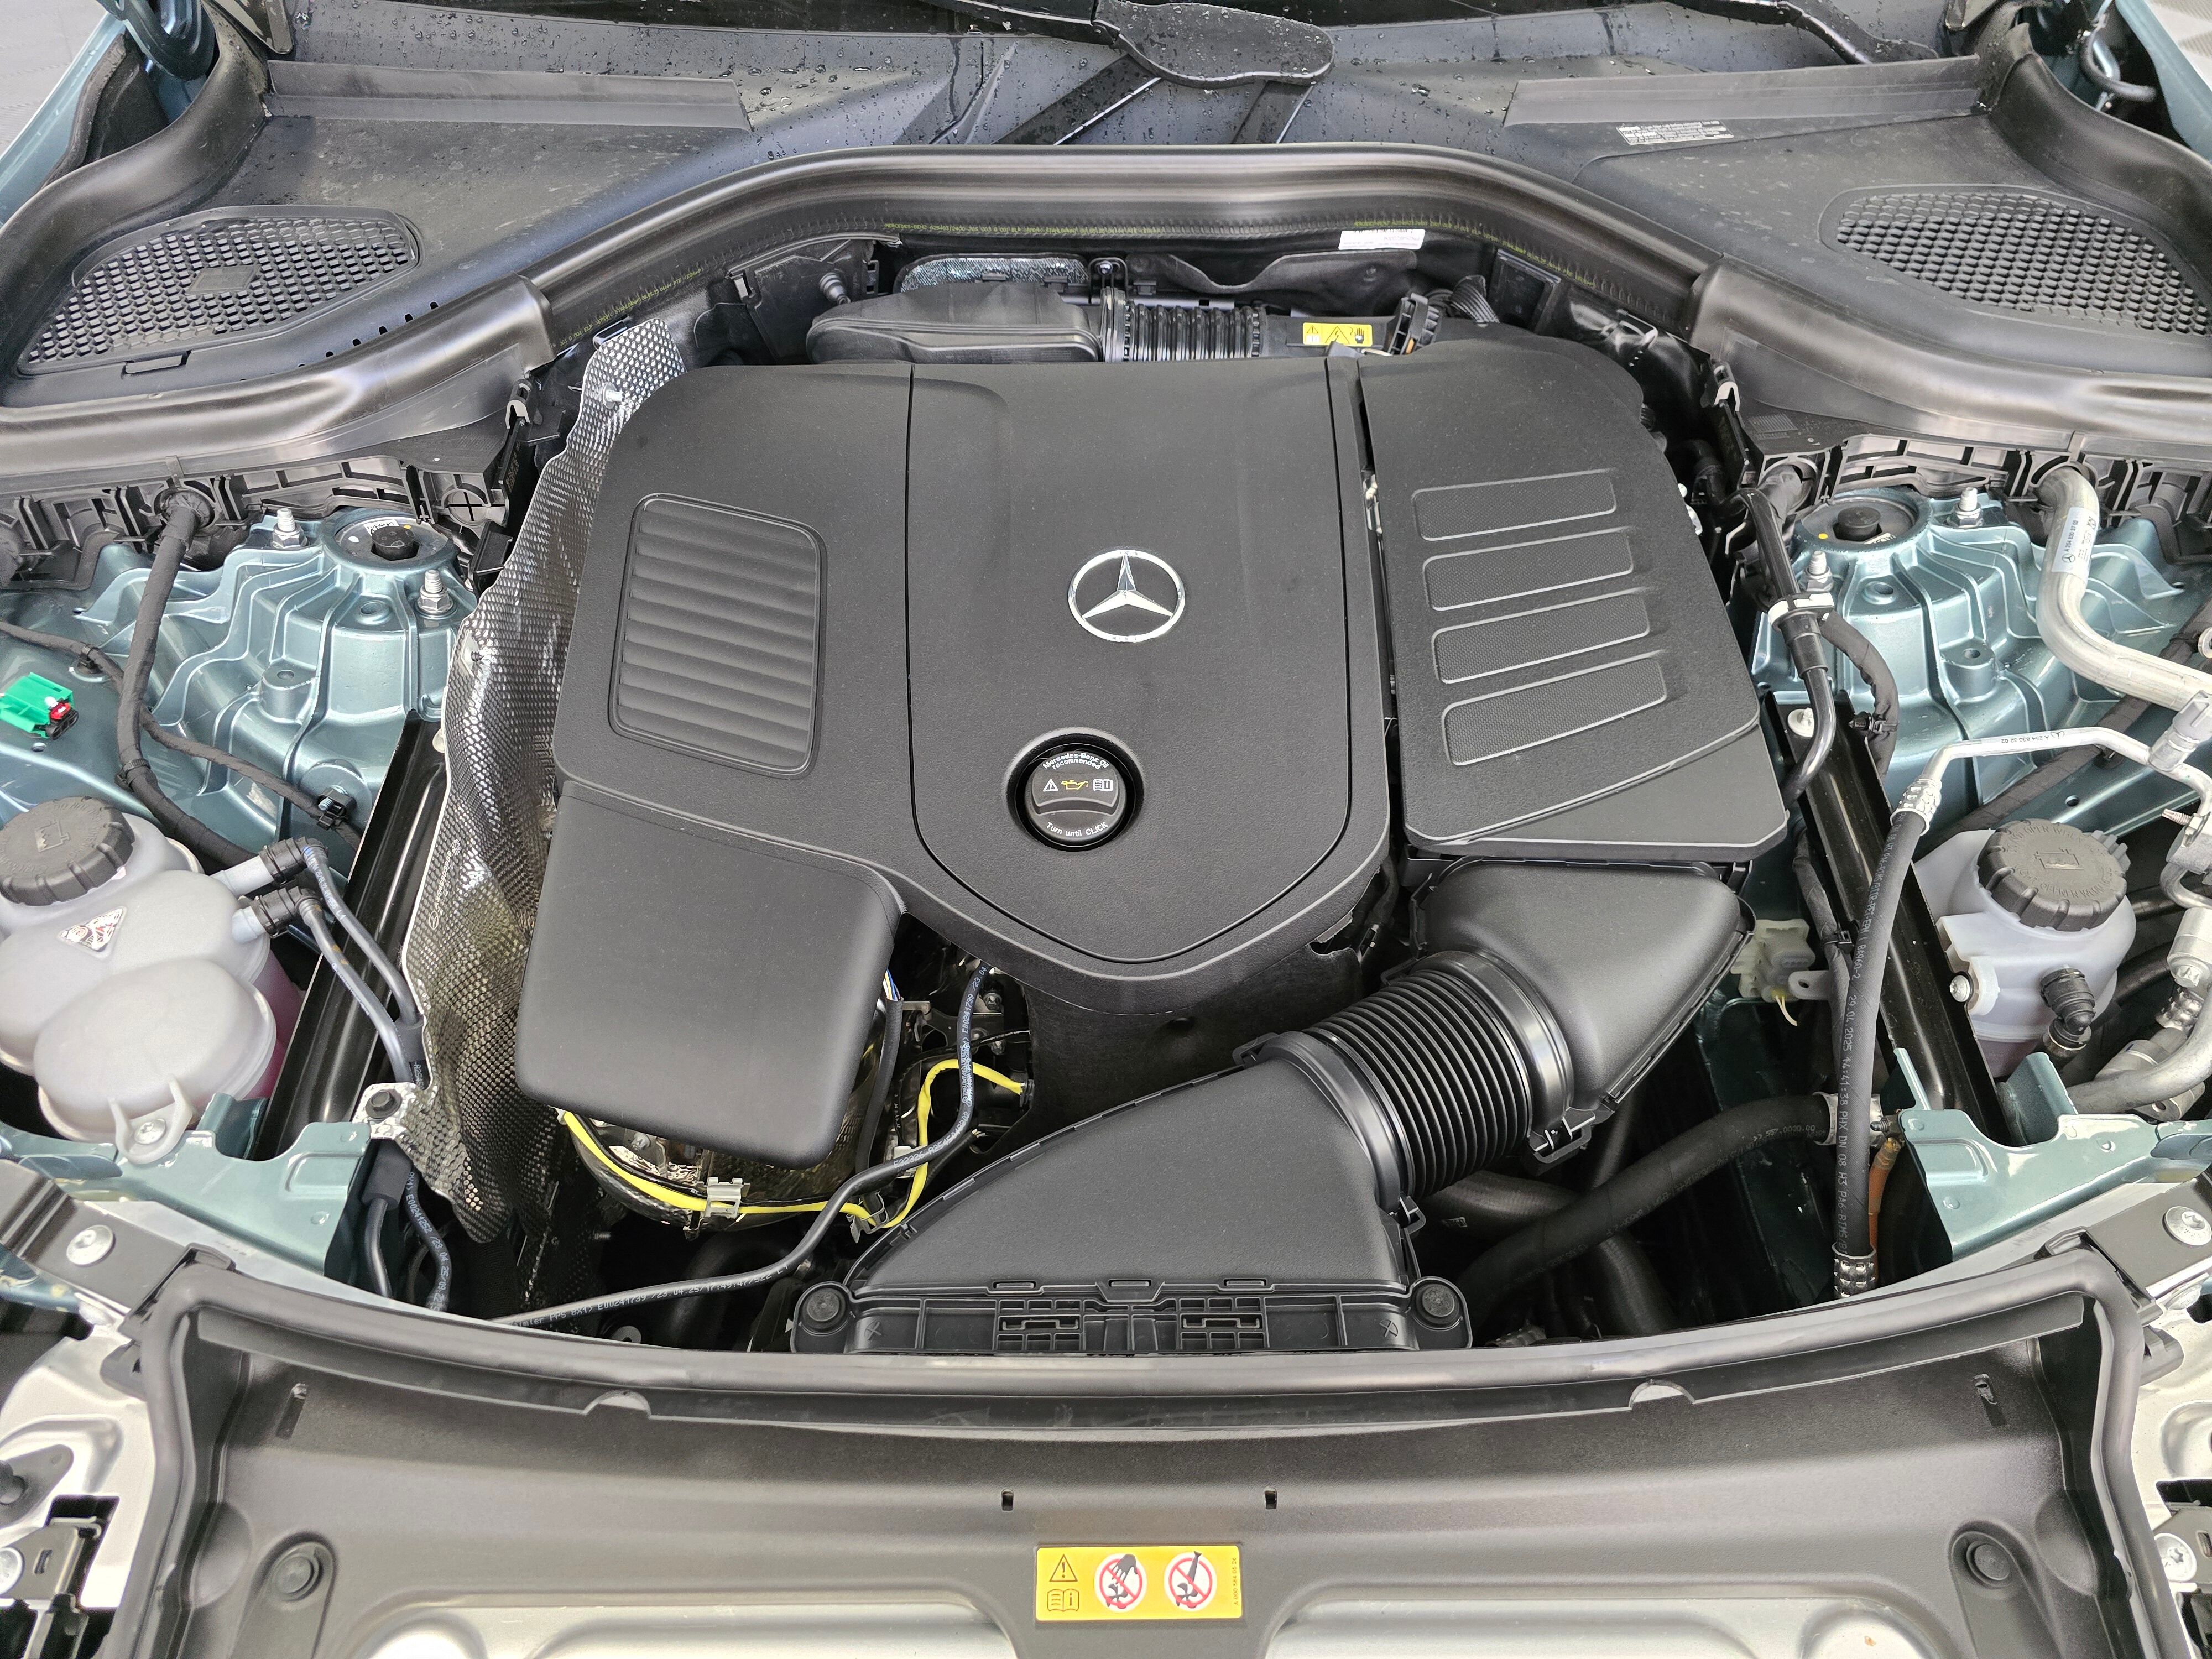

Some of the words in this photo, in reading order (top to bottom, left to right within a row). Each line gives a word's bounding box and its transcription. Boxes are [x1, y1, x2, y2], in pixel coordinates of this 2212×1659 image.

[1042, 752, 1099, 769] Mercedes-Benz
[1100, 759, 1110, 769] Oil
[1052, 758, 1101, 770] recommended
[1046, 821, 1063, 835] Turn
[1065, 829, 1082, 837] until
[1085, 821, 1109, 836] CLICK
[962, 993, 974, 1034] E00241739
[1843, 994, 1858, 1052] 29.04.2025
[1840, 1056, 1851, 1106] 14:41:38
[1839, 1110, 1849, 1131] PHX
[1838, 1135, 1848, 1149] DN
[1838, 1155, 1848, 1167] 08
[1838, 1172, 1848, 1186] H3
[405, 1193, 434, 1234] E00241252
[510, 1317, 544, 1328] aimler
[549, 1312, 567, 1321] PPS
[597, 1294, 646, 1311] E00241739
[1232, 1566, 1237, 1574] 05
